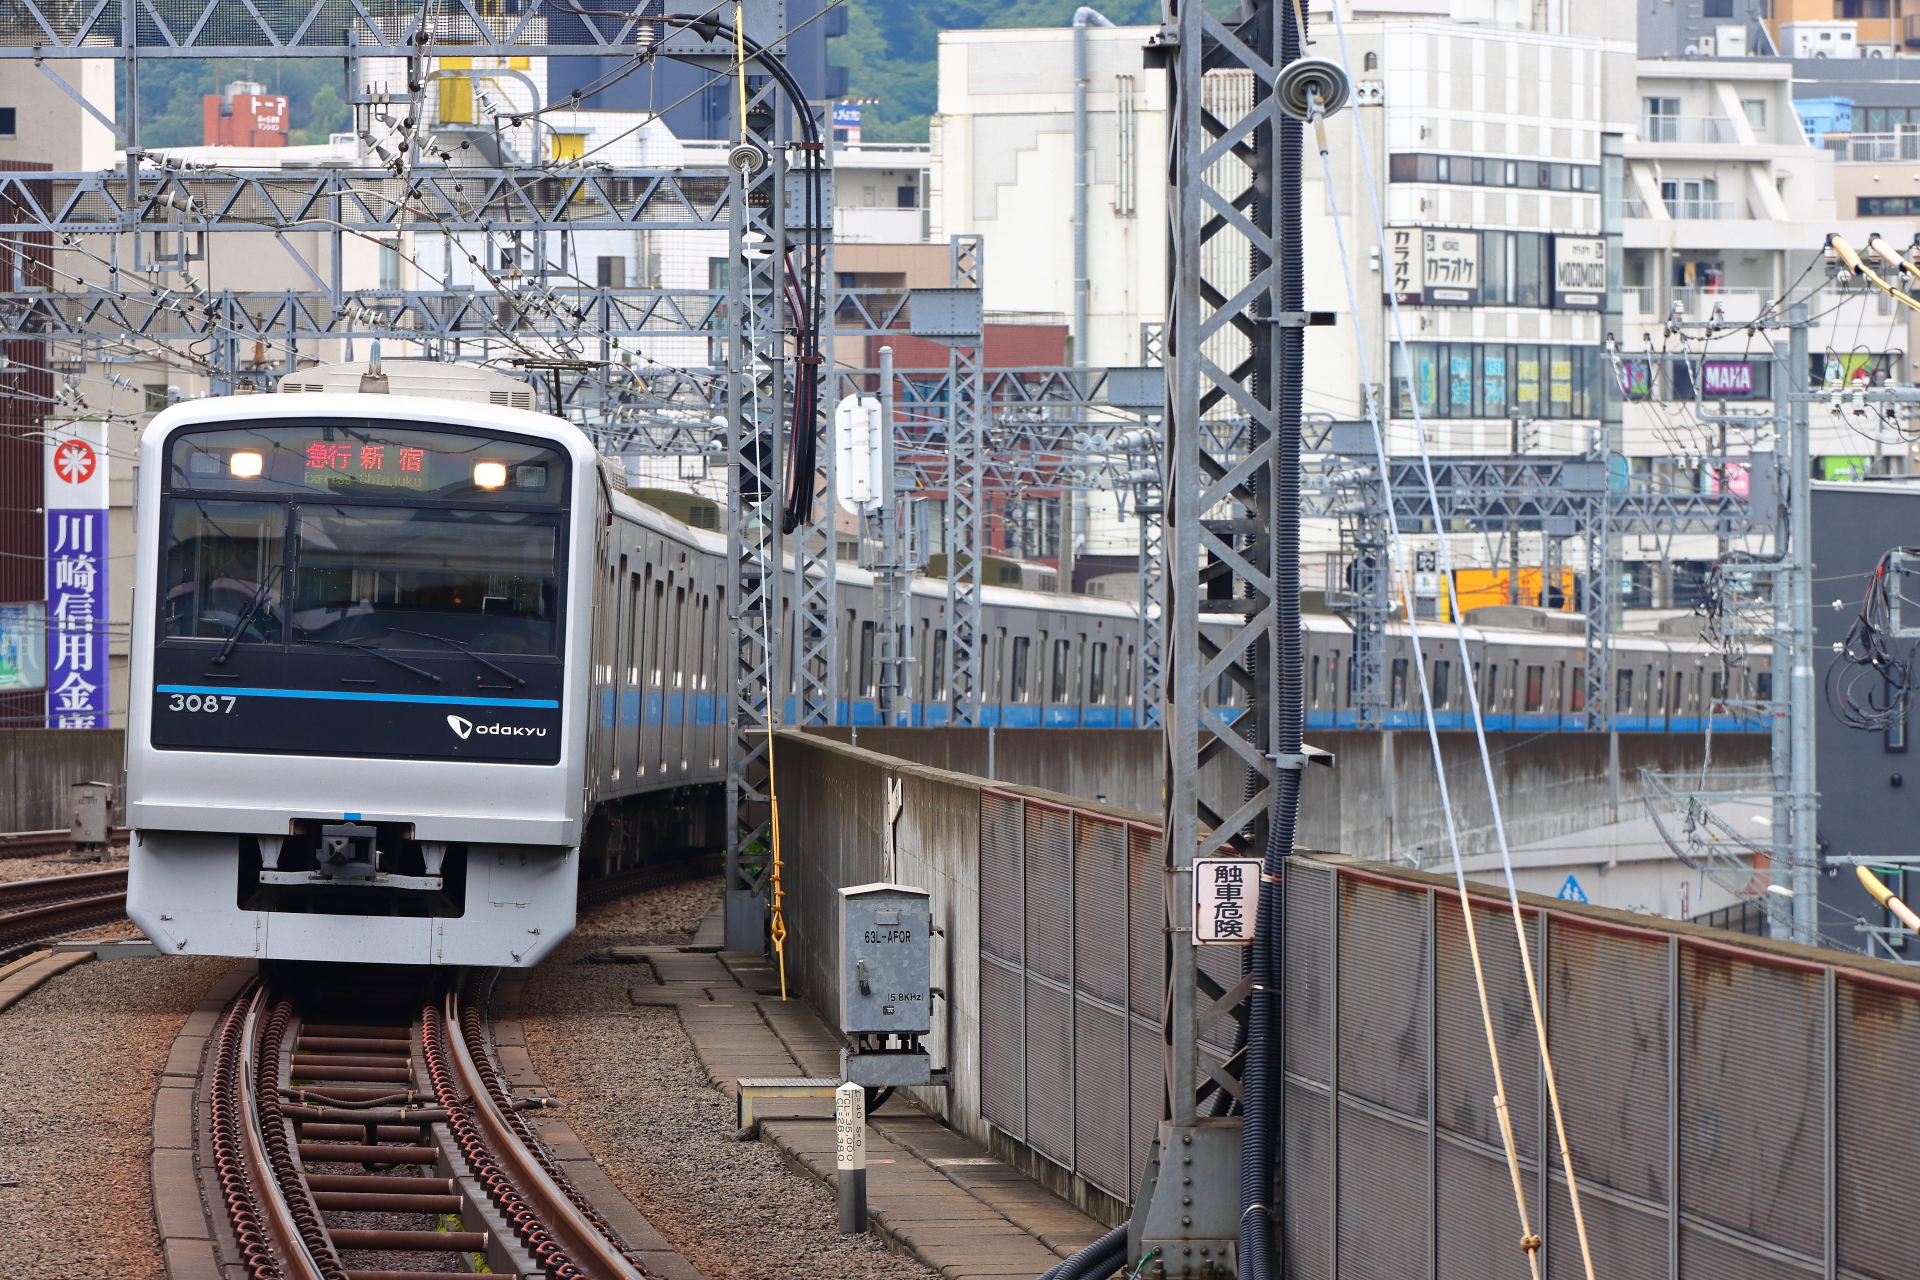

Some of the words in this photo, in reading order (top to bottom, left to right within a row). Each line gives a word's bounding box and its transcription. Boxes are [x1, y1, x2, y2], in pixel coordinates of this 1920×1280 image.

[251, 96, 286, 116] トーア
[1394, 231, 1410, 291] カラオケ
[1427, 257, 1474, 282] カラオケ
[1705, 367, 1750, 389] MAHA
[359, 472, 422, 488] Shinjuku
[168, 693, 237, 714] 3087
[476, 723, 546, 737] odakyu
[1213, 865, 1244, 938] 触車危険
[864, 930, 911, 943] 63L-AFOR
